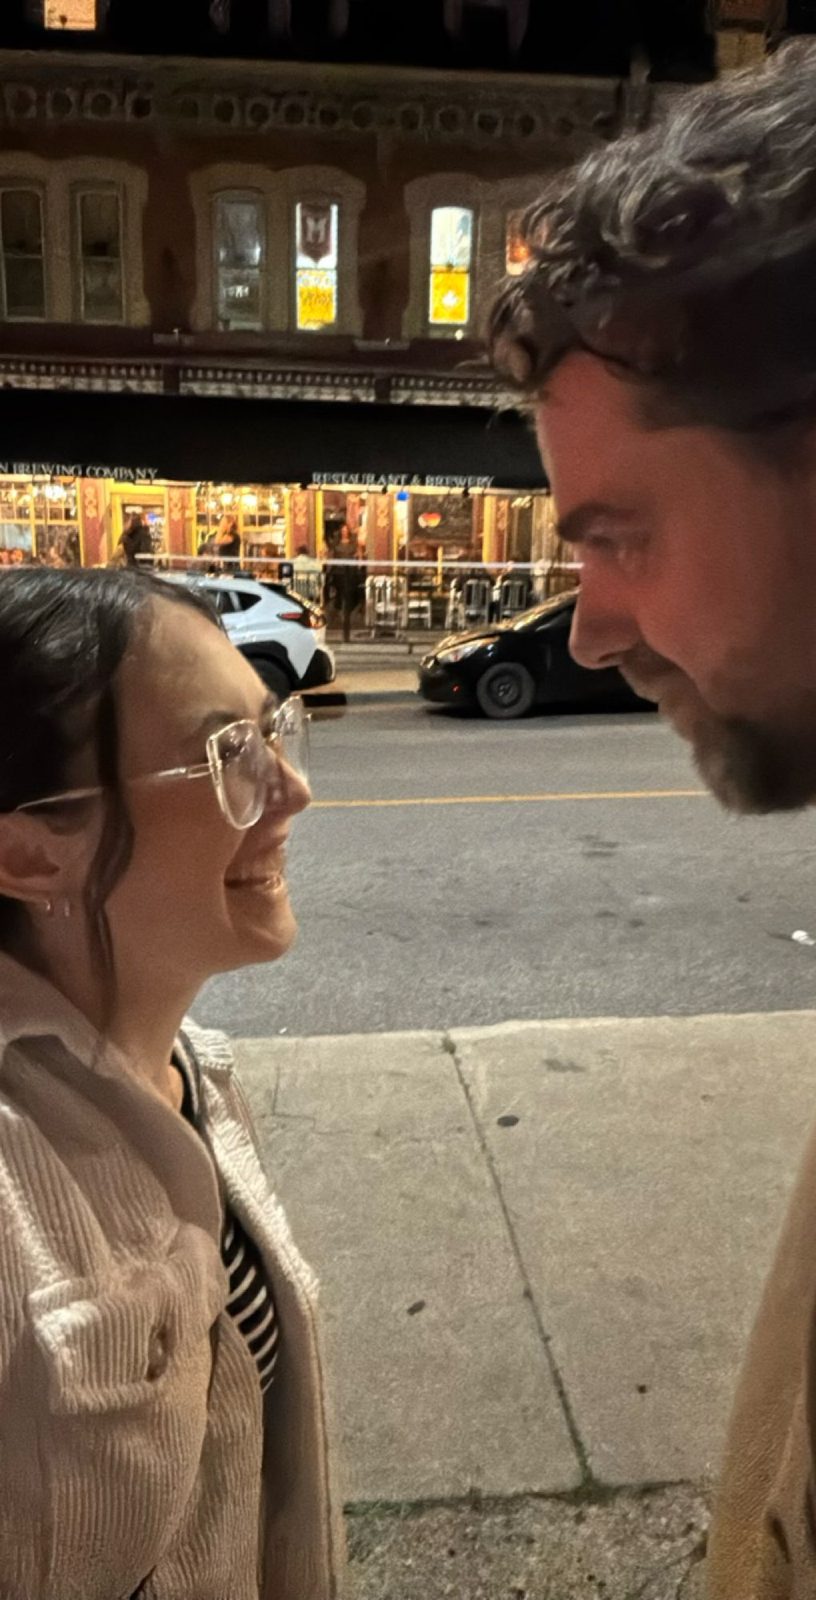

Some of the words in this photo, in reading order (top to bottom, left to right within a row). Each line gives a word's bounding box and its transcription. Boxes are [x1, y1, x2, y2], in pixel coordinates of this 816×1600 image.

[13, 462, 82, 477] BREWING
[86, 466, 158, 480] COMPANY
[312, 472, 408, 485] RESTAURANT
[411, 474, 421, 486] &
[425, 475, 494, 488] BREWERY
